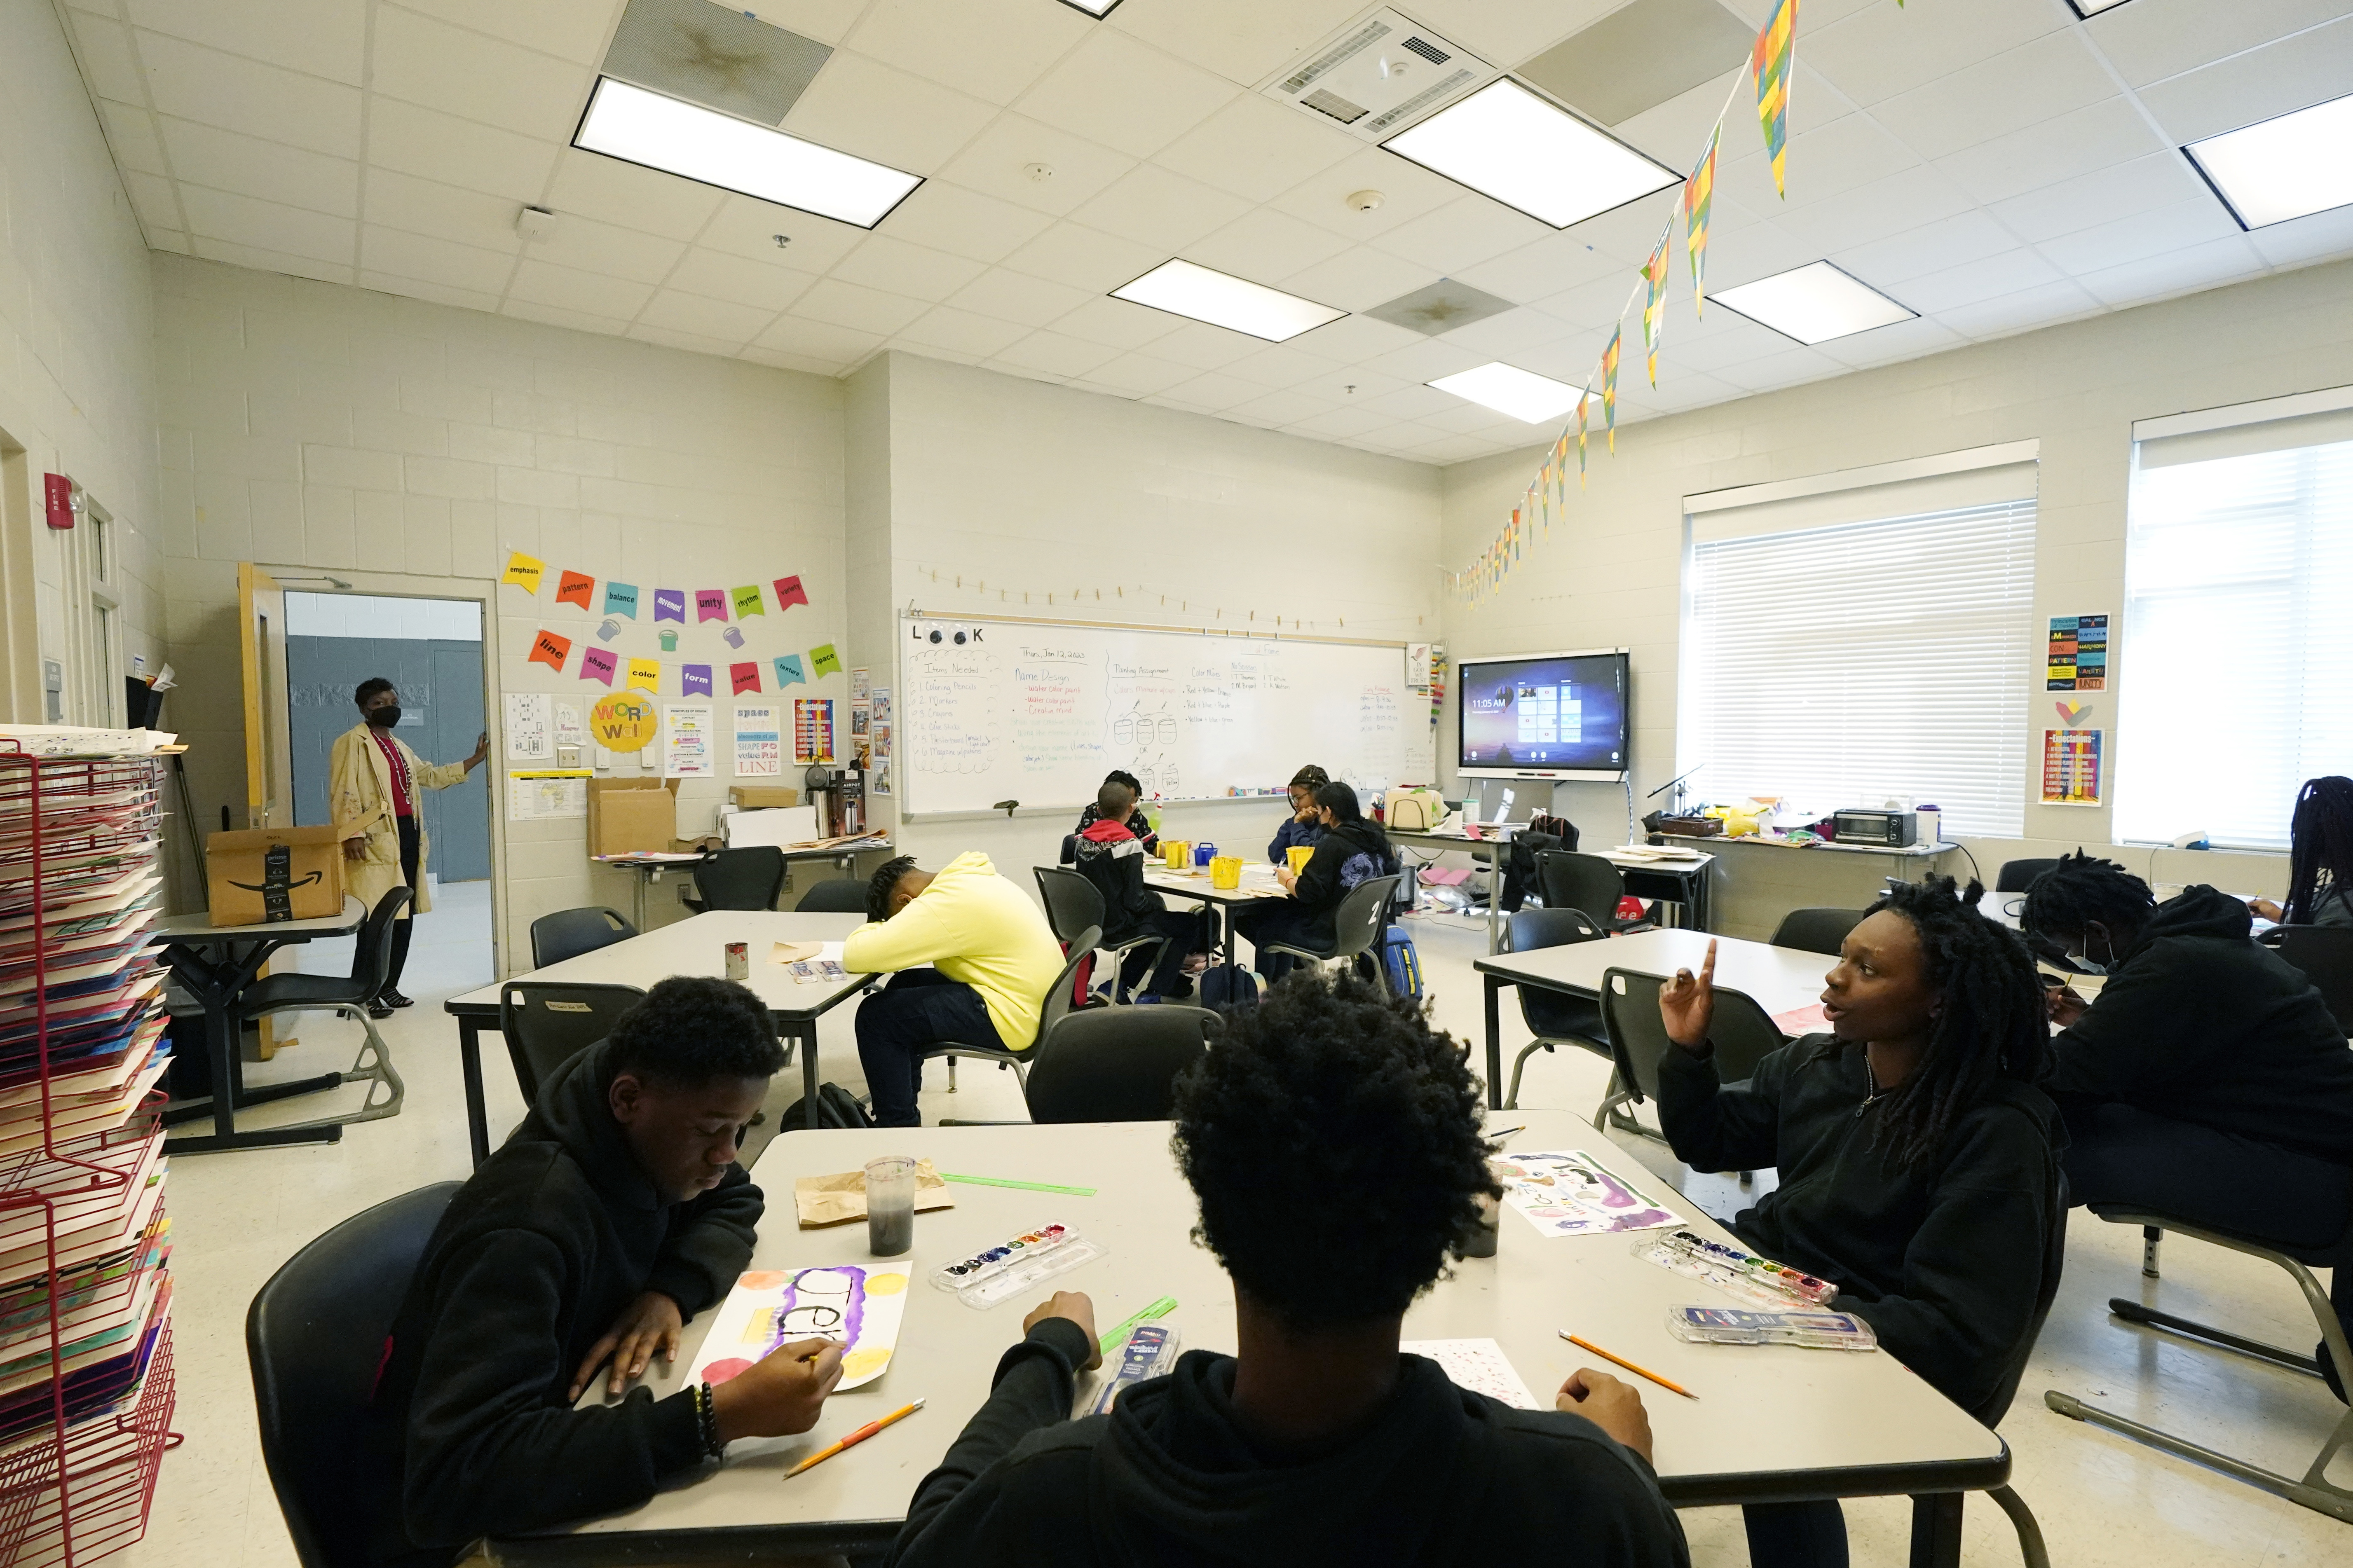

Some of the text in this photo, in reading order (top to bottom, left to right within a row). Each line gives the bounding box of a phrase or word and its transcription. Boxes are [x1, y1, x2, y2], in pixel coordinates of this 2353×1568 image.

[562, 583, 589, 594] pattern
[780, 583, 801, 596] variety
[609, 592, 635, 603] balance
[738, 594, 759, 608] rhythm
[657, 597, 682, 613] movement
[699, 598, 722, 610] unity
[540, 639, 563, 660] line
[1264, 644, 1280, 655] Fame
[587, 656, 612, 672] shape
[815, 653, 834, 665] space
[633, 670, 656, 679] color
[780, 664, 800, 676] texture
[924, 663, 979, 674] Items Needed
[1139, 667, 1169, 677] Assignment
[1192, 667, 1205, 677] Color
[684, 672, 708, 684] form
[735, 674, 755, 684] value
[1015, 668, 1069, 685] Name Design
[926, 681, 951, 694] Coloring
[954, 682, 977, 690] Pencils
[1186, 685, 1196, 694] Red
[2079, 679, 2102, 688] UNITY
[1187, 700, 1196, 709] Red
[1473, 698, 1505, 707] 11:05 AM
[595, 702, 652, 721] WORD
[738, 709, 769, 718] space
[929, 708, 953, 718] Crayons
[602, 723, 642, 739] Wall
[930, 747, 955, 759] Magazine
[739, 761, 777, 773] LINE
[1368, 901, 1380, 925] 2
